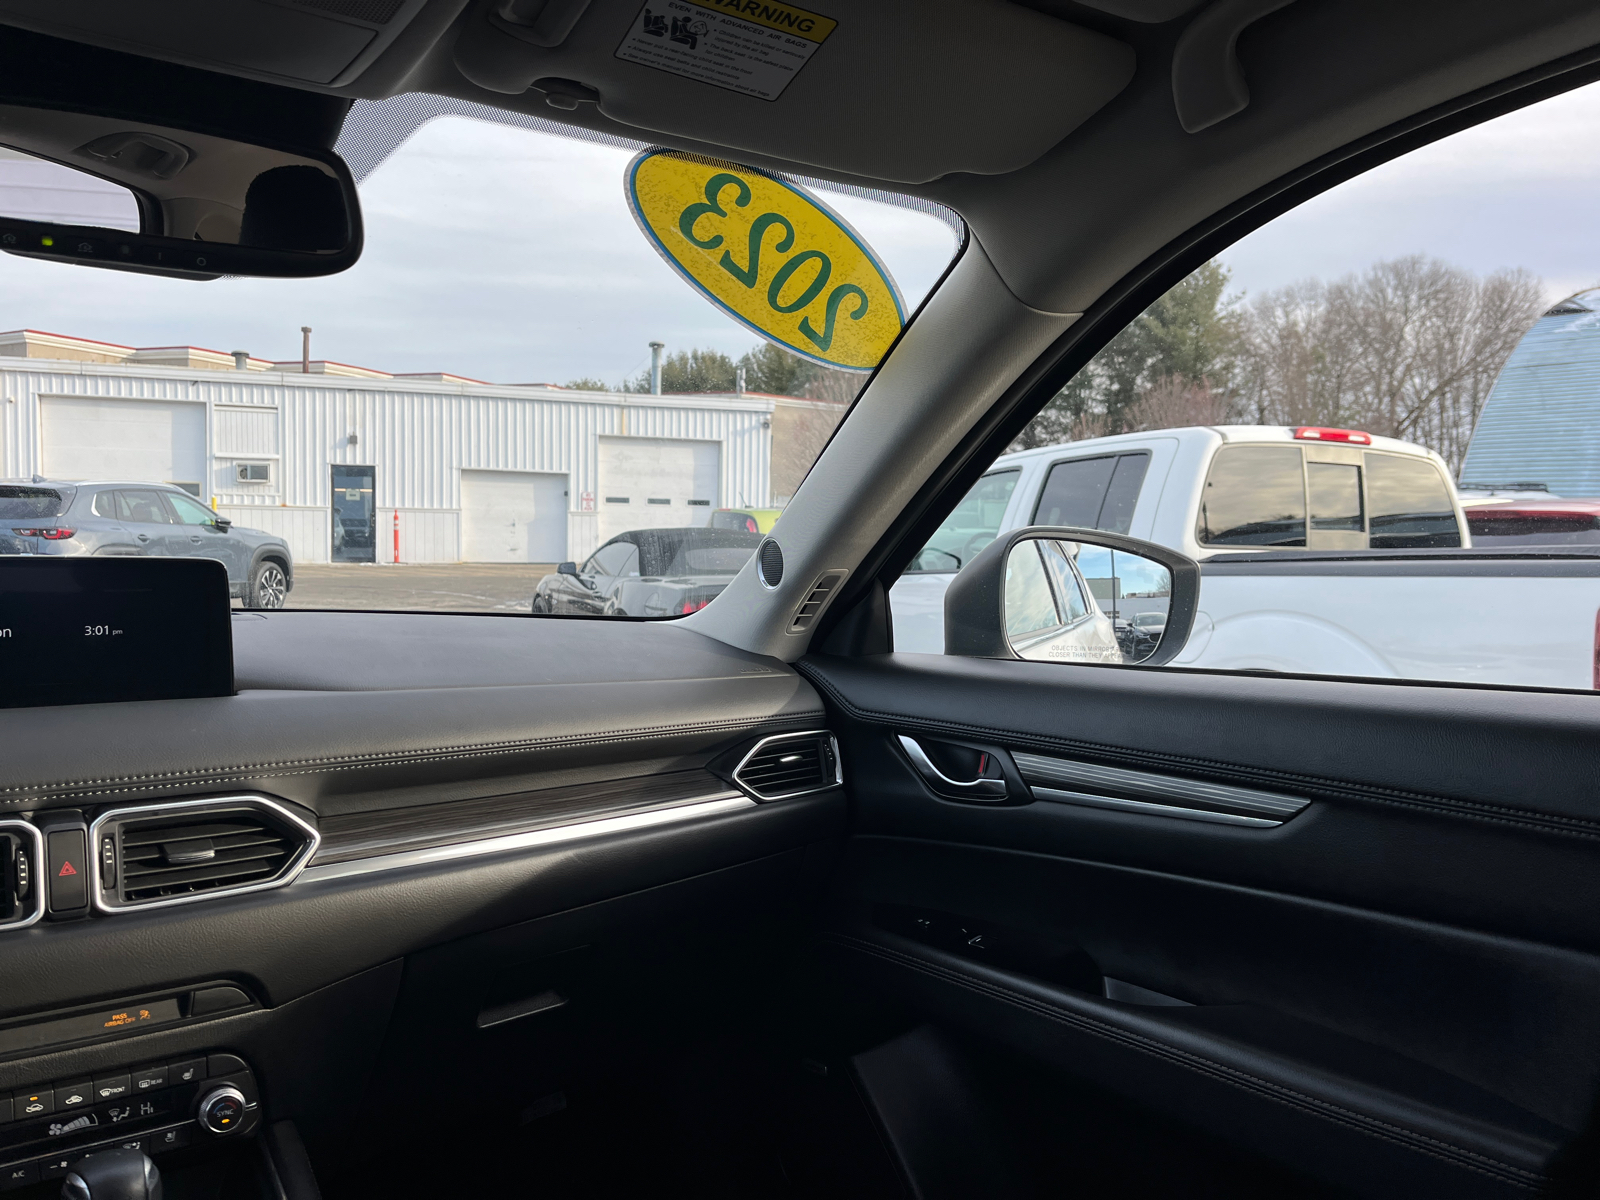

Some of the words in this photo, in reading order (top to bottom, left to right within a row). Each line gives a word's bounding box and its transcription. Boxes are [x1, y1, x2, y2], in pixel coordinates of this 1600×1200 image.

[668, 2, 691, 13] EVEN
[695, 10, 717, 21] WITH
[720, 18, 764, 35] ADVANCED
[767, 33, 782, 41] AIR
[785, 37, 807, 49] BAGS
[718, 30, 742, 40] Children
[84, 625, 109, 636] 3:01
[1048, 651, 1070, 659] CLOSER
[112, 1012, 127, 1021] PASS
[104, 1019, 124, 1028] AIRBAG
[110, 1086, 126, 1094] FRONT
[216, 1108, 235, 1118] SYNC
[11, 1170, 25, 1179] A/C
